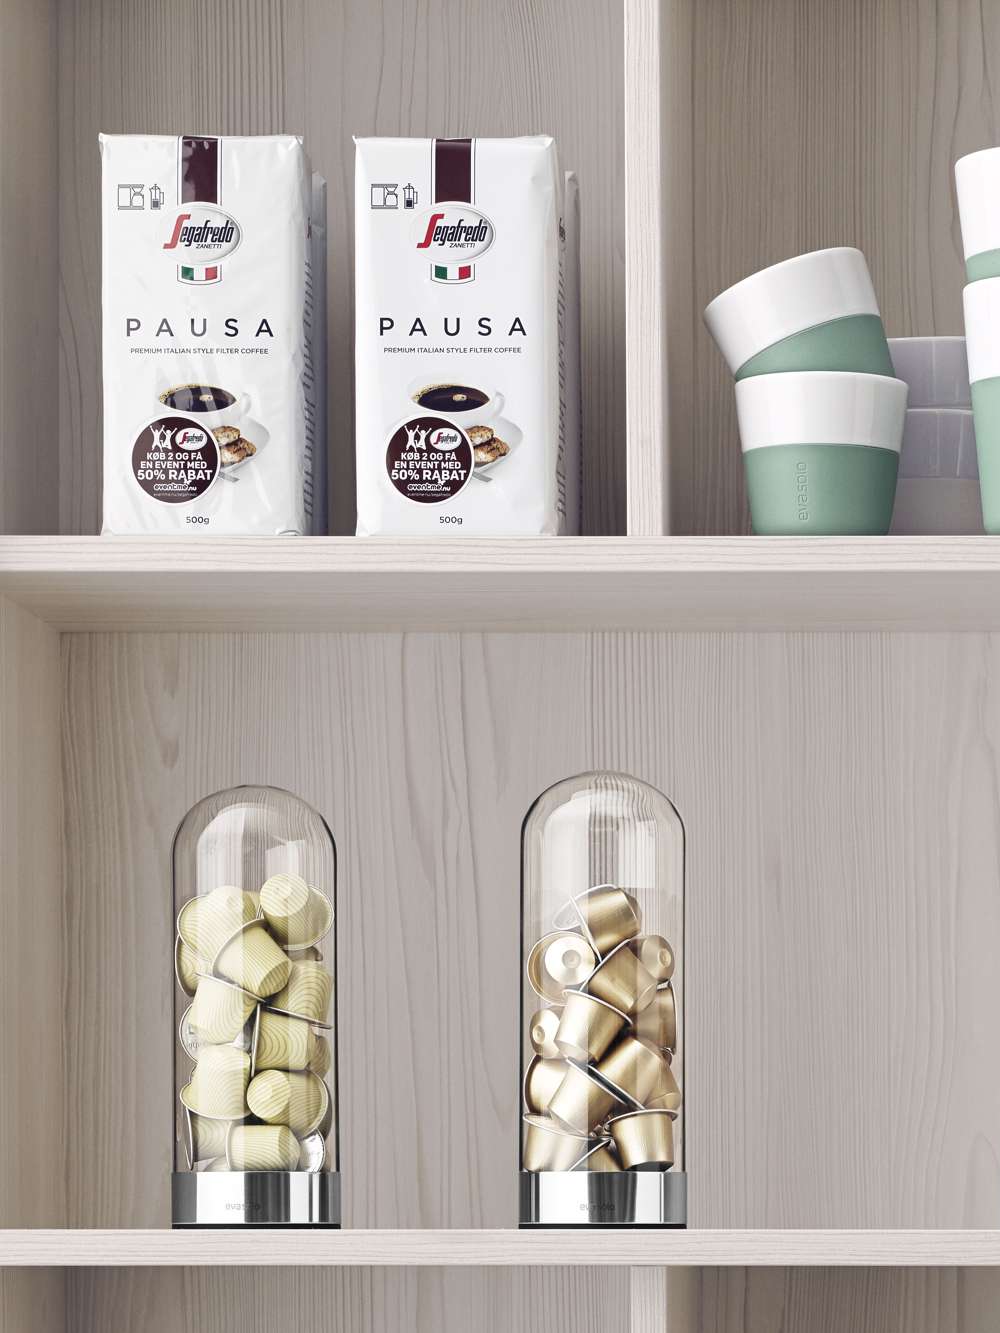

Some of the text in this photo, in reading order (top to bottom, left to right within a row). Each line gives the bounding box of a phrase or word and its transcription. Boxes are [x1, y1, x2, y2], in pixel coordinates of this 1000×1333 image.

[163, 214, 235, 249] Segafredo
[416, 213, 488, 248] Segafredo
[126, 318, 274, 337] PAUSA
[379, 317, 527, 336] PAUSA
[130, 347, 269, 355] PREMIUM ITALIAN STYLE FILTER COFFEE
[146, 452, 203, 460] KØB 2 OG FÅ
[401, 452, 457, 460] KØB 2 OG FÅ
[140, 461, 207, 469] EN EVENT MED
[394, 461, 461, 469] EN EVENT MED
[137, 470, 213, 480] 50% RABAT
[391, 470, 467, 480] 50% RABAT
[186, 516, 210, 525] 500g
[440, 516, 463, 525] 500g
